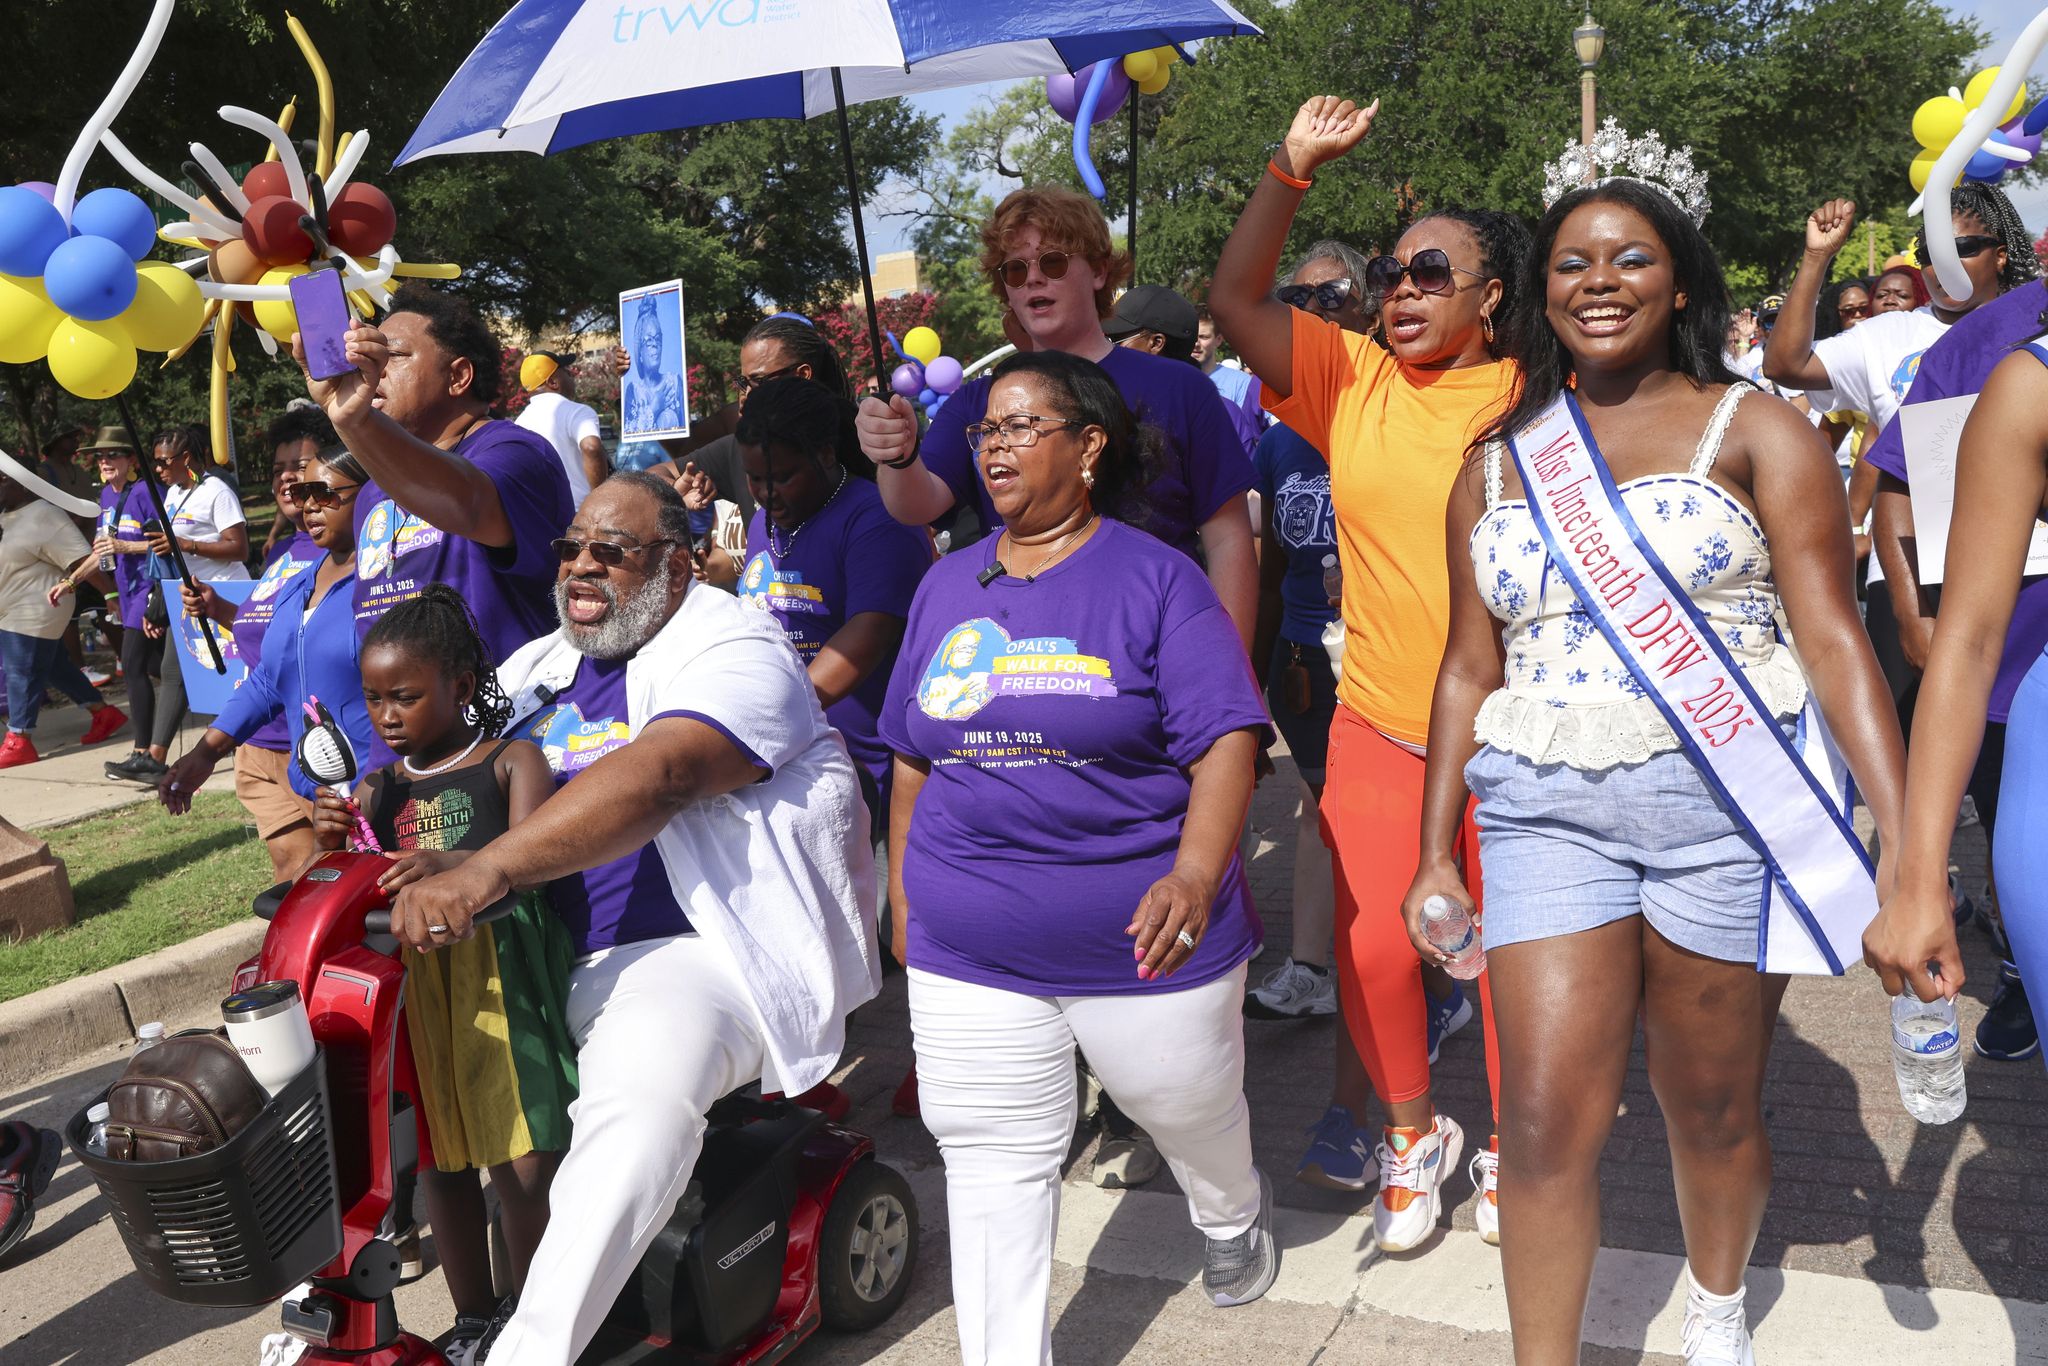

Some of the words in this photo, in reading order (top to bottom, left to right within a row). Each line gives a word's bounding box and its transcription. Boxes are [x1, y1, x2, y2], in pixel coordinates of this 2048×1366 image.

[1529, 430, 1577, 483] Miss
[1546, 474, 1646, 610] Juneteenth
[397, 579, 415, 591] 2025
[1623, 598, 1708, 680] DFW
[1006, 641, 1057, 654] OPAL'S
[1006, 659, 1052, 673] WALK
[1055, 659, 1088, 674] FOR
[1001, 677, 1091, 692] FREEDOM
[1680, 677, 1754, 748] 2025
[963, 731, 992, 744] JUNE
[995, 731, 1013, 744] 19,
[1015, 731, 1043, 744] 2025
[962, 748, 979, 757] PST
[986, 748, 1005, 757] 9AM
[1006, 747, 1022, 757] CST
[1004, 758, 1036, 768] WORTH,
[1038, 757, 1049, 765] TX
[397, 810, 469, 838] JUNETEENTH
[239, 1046, 262, 1056] Horn
[1926, 1037, 1954, 1051] WATER
[723, 1234, 761, 1265] VICTORY
